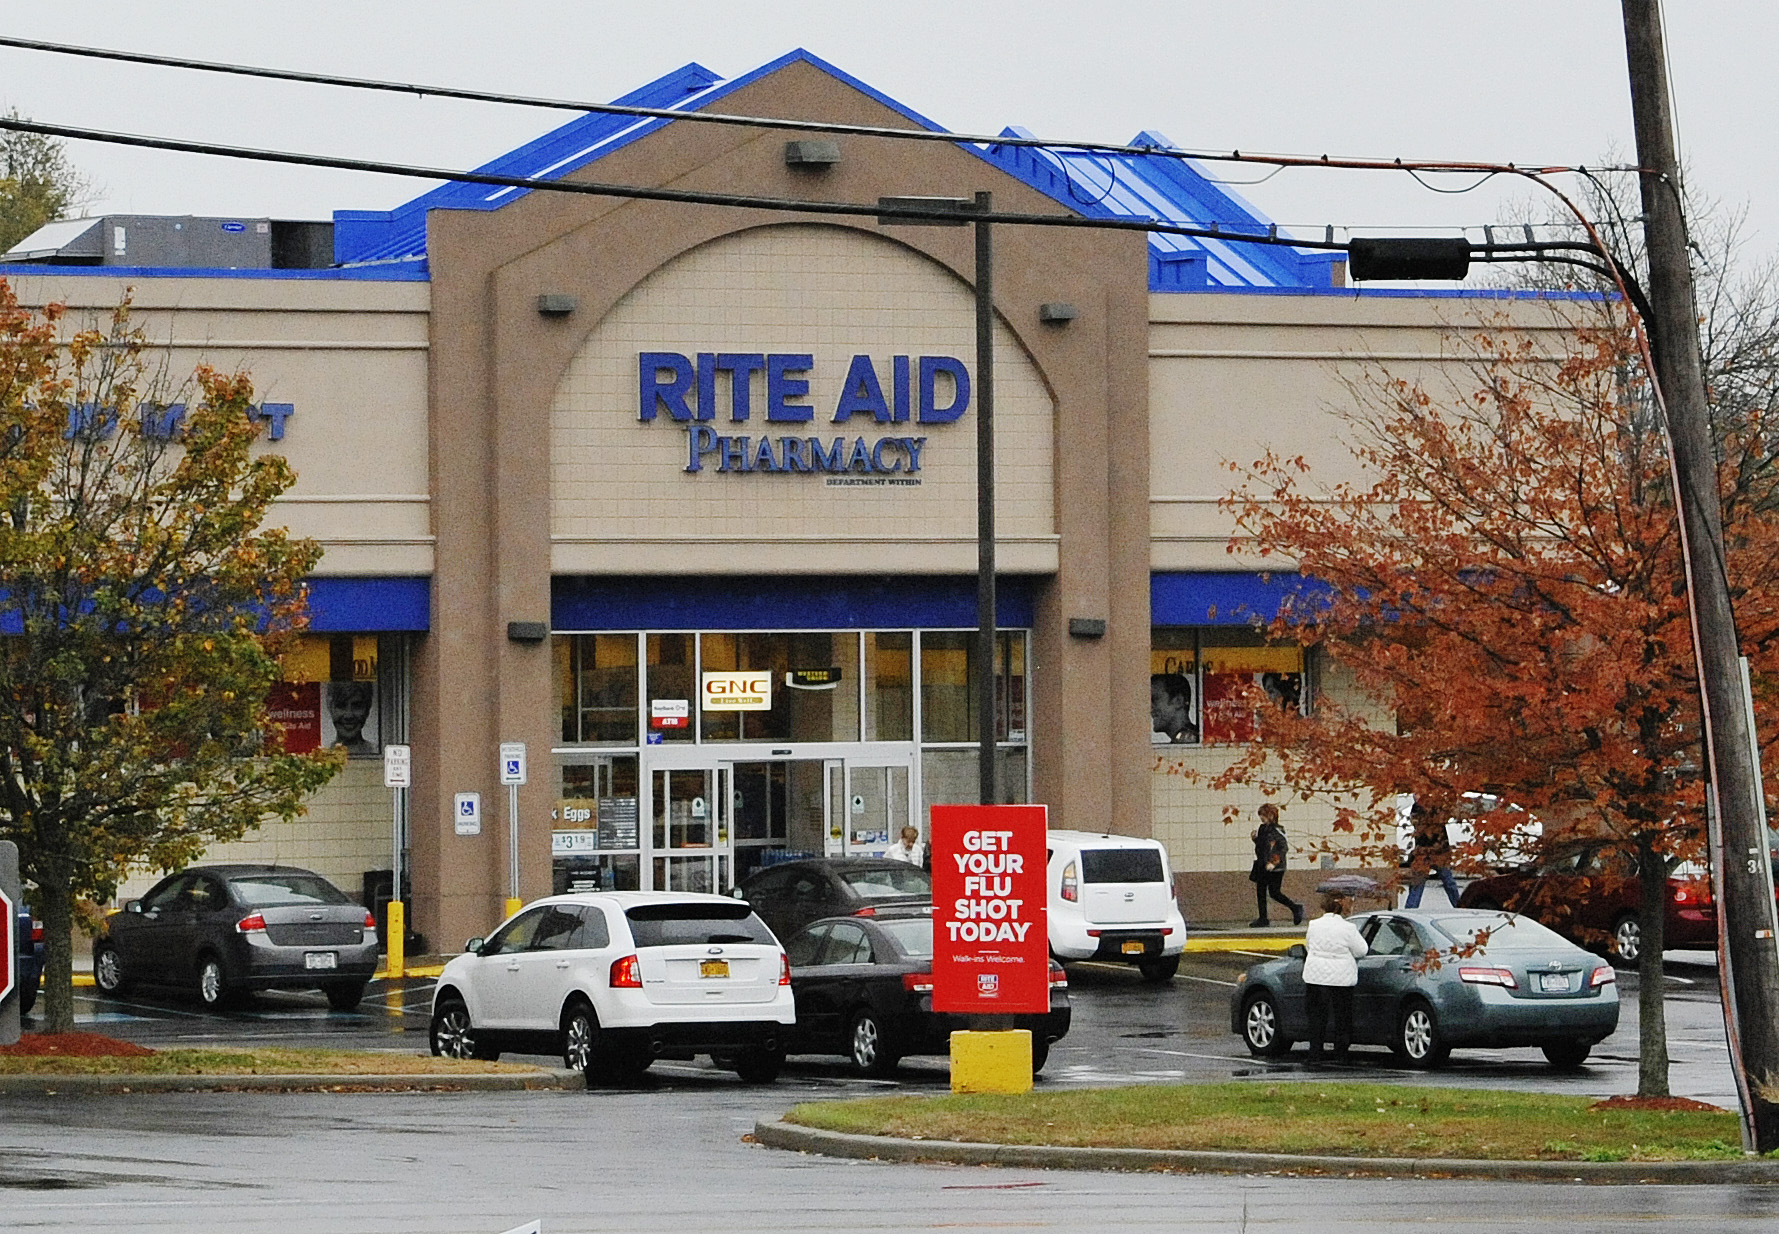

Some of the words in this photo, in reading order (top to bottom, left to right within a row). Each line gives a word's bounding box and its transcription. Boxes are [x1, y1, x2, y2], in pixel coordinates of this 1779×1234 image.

[638, 352, 814, 422] RITE
[831, 355, 971, 424] AID
[826, 478, 887, 486] DEPARTMENT
[888, 478, 922, 487] WITHIN
[706, 680, 769, 694] GNC
[563, 805, 592, 822] Eggs
[963, 831, 1013, 851] GET
[953, 854, 1024, 874] YOUR
[965, 876, 1012, 897] FLU
[955, 899, 1024, 920] SHOT
[946, 922, 1032, 942] TODAY
[952, 955, 985, 963] Walk-ins
